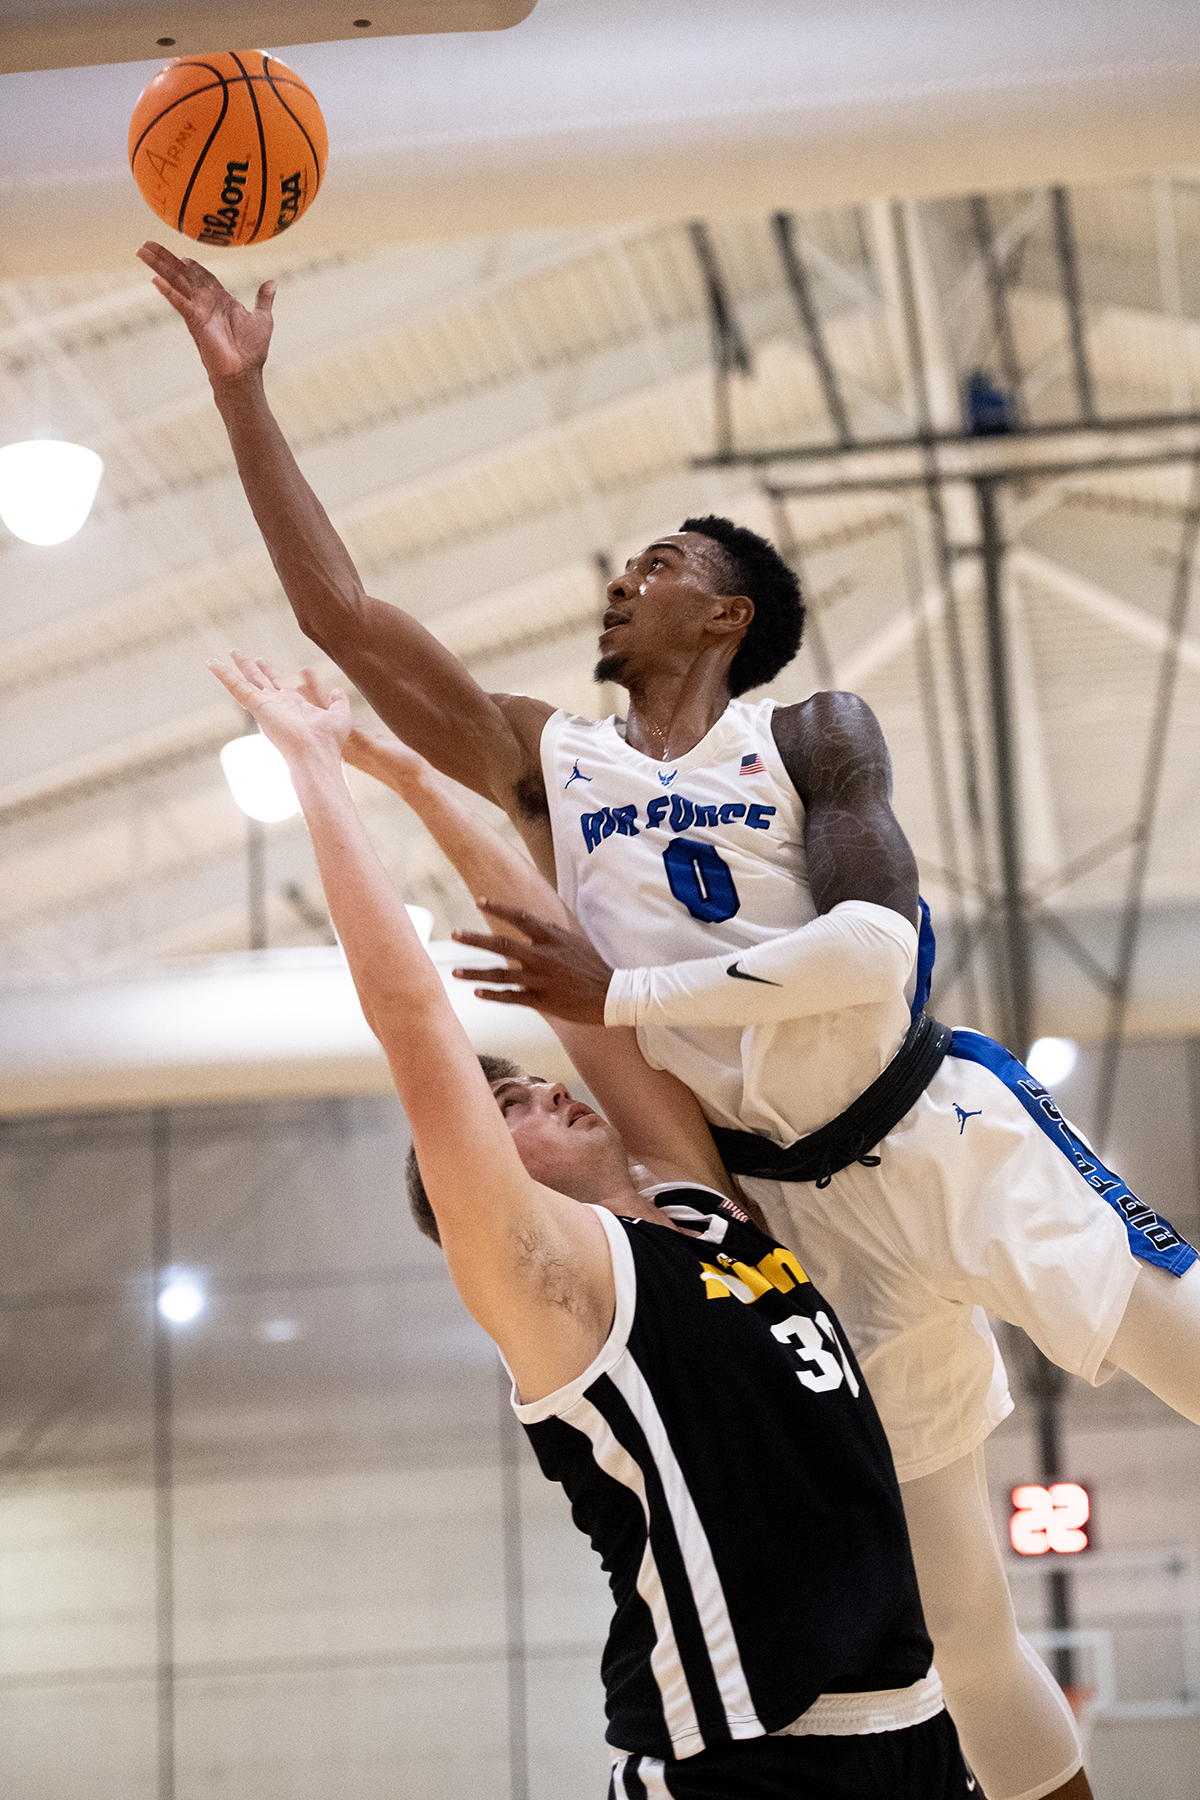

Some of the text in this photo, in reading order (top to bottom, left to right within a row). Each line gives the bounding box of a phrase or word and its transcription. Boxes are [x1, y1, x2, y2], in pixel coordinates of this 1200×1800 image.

[580, 793, 776, 855] AIR FORCE
[661, 837, 741, 924] 0
[1017, 1079, 1121, 1195] FCE
[1009, 1482, 1091, 1556] 22
